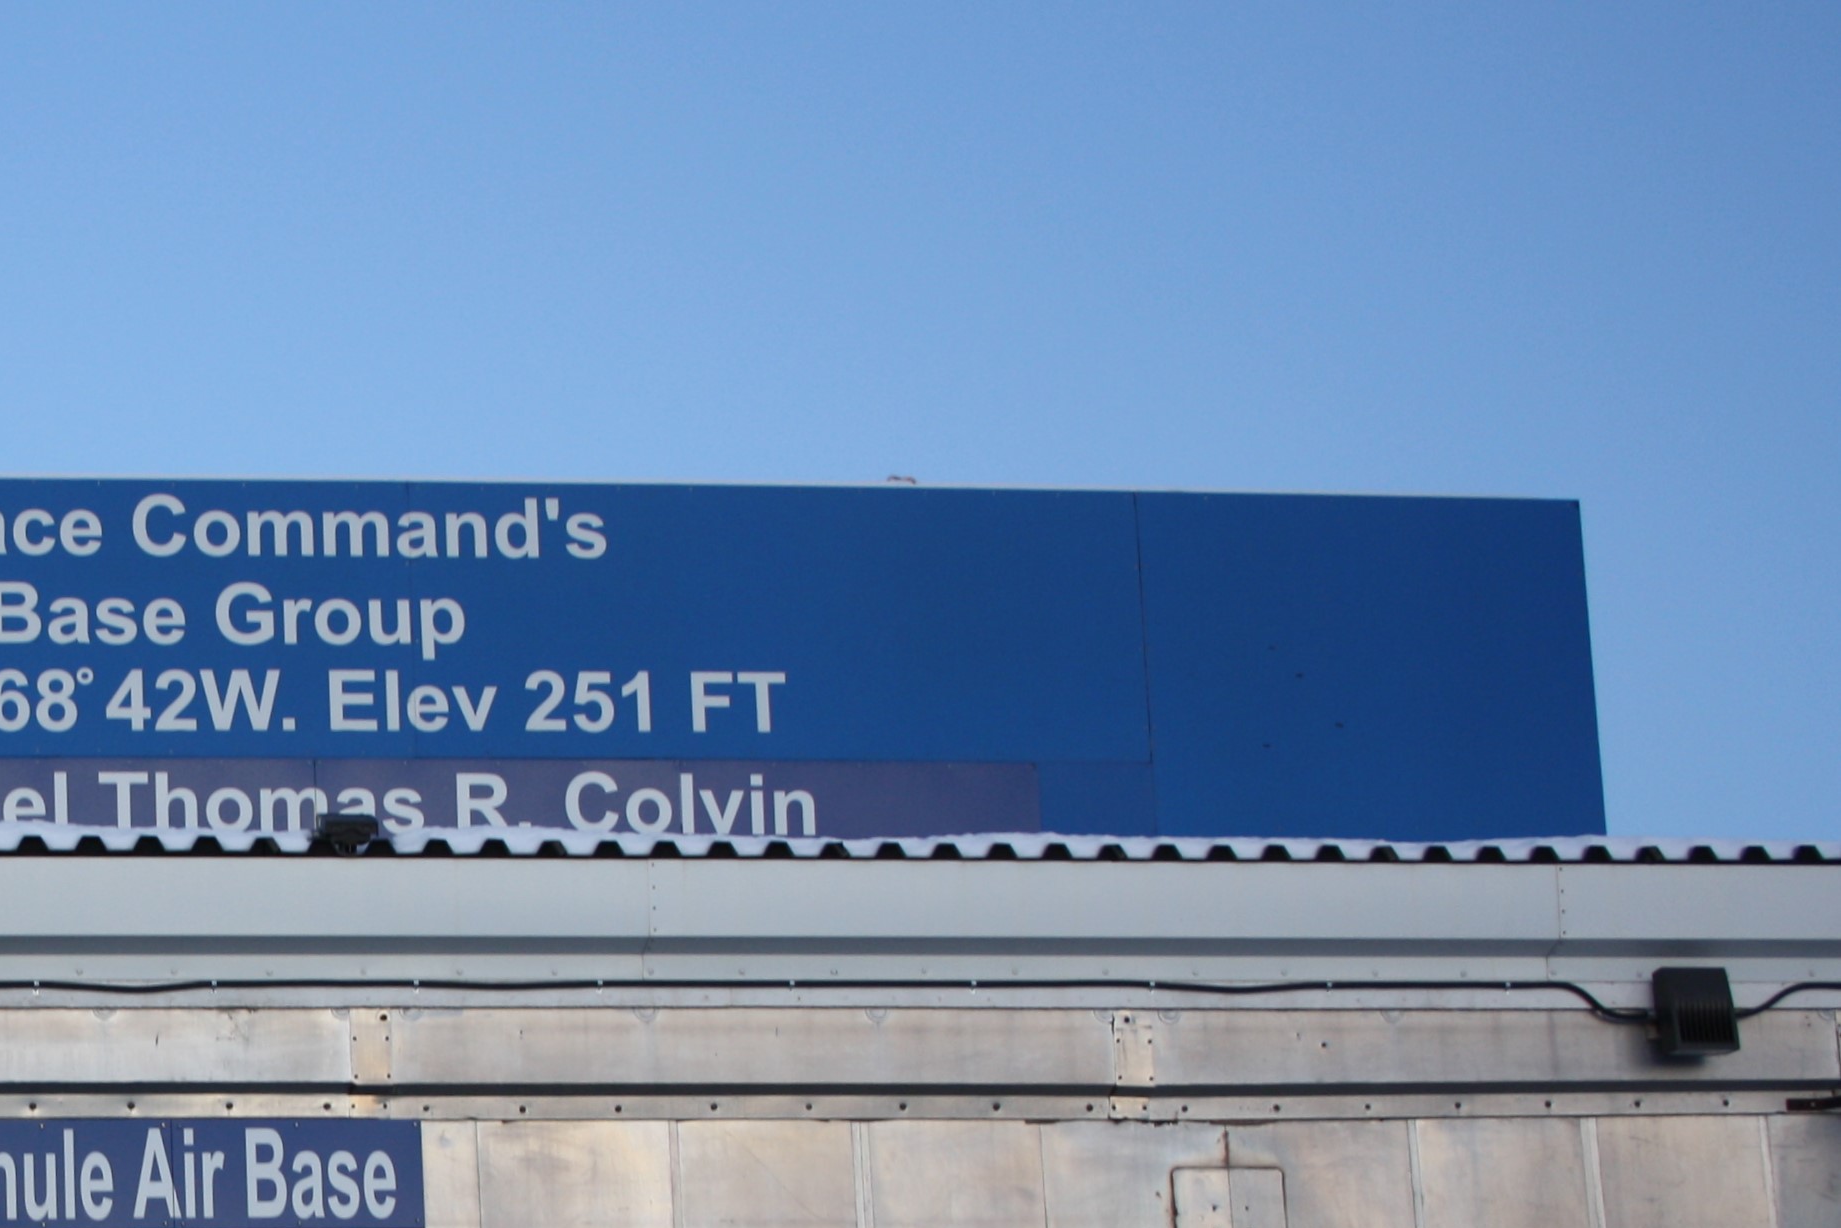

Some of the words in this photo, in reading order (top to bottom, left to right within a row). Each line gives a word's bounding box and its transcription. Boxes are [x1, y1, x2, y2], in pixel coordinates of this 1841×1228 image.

[132, 494, 607, 559] Command's
[216, 582, 465, 660] Group
[329, 669, 497, 732] Elev
[526, 671, 651, 732] 251
[691, 672, 785, 732] FT
[98, 770, 424, 834] Thomas
[565, 771, 816, 837] Colvin
[134, 1127, 225, 1220] Air
[245, 1127, 397, 1220] Base
